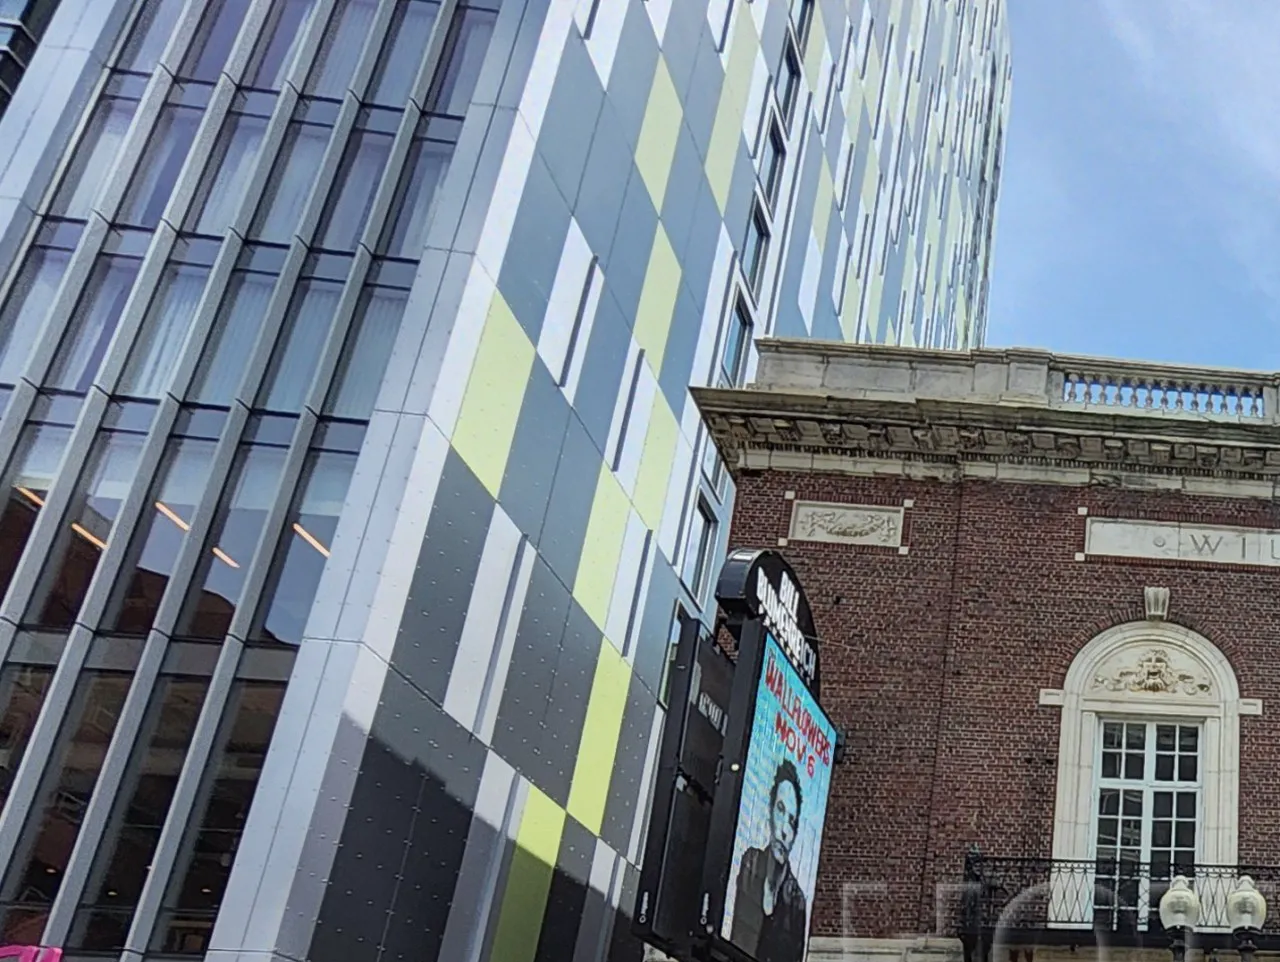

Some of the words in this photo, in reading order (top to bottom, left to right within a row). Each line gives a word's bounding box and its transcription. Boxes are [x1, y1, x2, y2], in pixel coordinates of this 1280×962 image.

[757, 566, 816, 681] BLUMENREICH
[779, 569, 799, 624] BILL
[776, 711, 806, 763] NOV
[807, 754, 815, 778] 6
